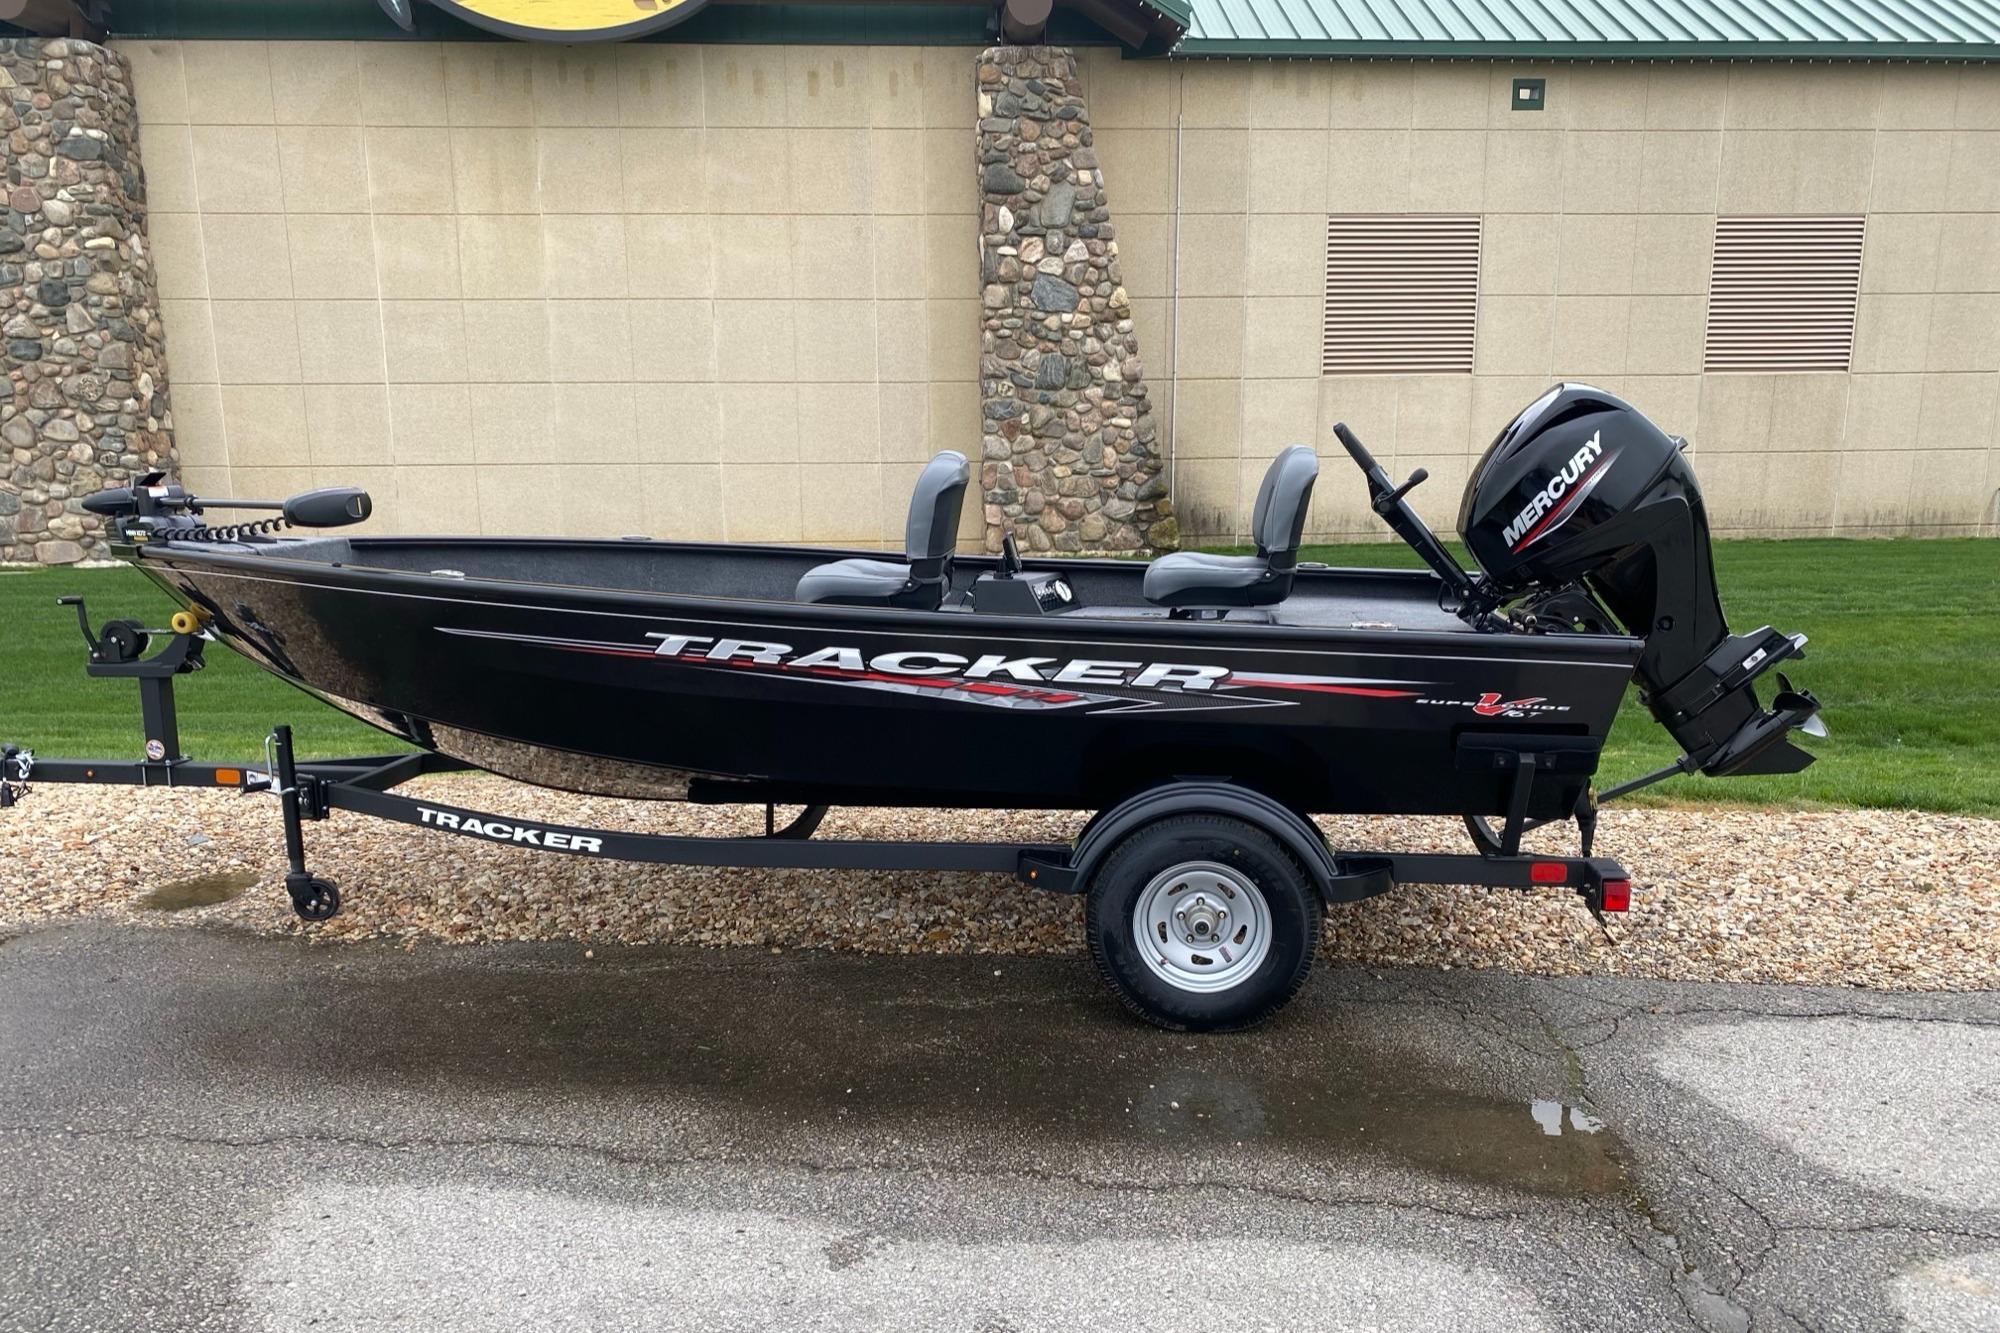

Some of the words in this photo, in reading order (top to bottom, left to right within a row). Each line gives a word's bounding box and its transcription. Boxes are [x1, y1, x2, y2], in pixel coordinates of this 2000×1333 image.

[1502, 429, 1602, 548] MERCURY
[645, 632, 1233, 690] TRACKER
[416, 797, 603, 853] TRACKER
